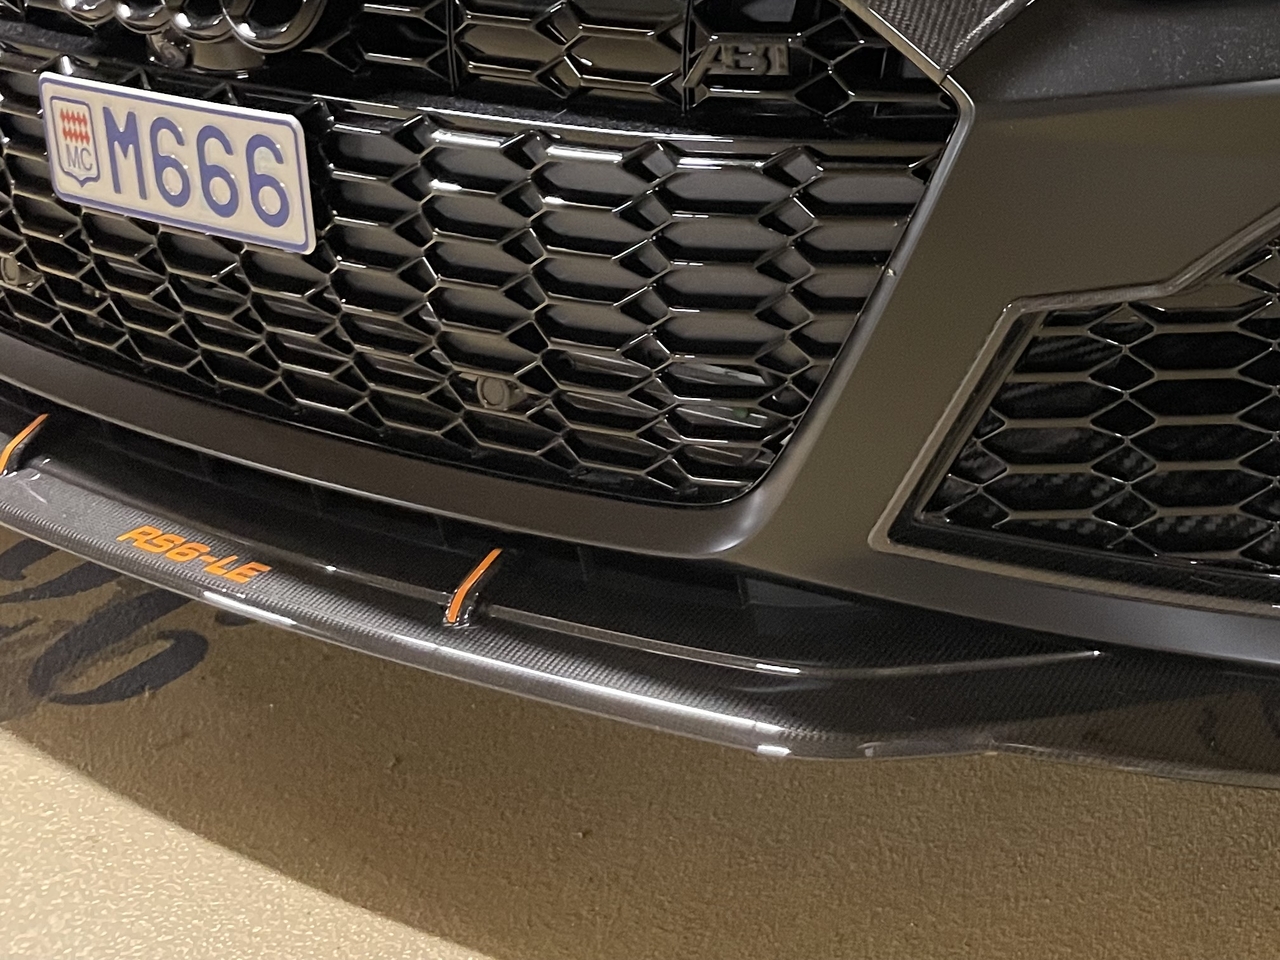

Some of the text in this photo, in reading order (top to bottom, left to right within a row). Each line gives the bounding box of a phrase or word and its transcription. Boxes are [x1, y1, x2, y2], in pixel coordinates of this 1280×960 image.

[66, 106, 290, 228] MC M666
[116, 525, 272, 584] RS6-LE
